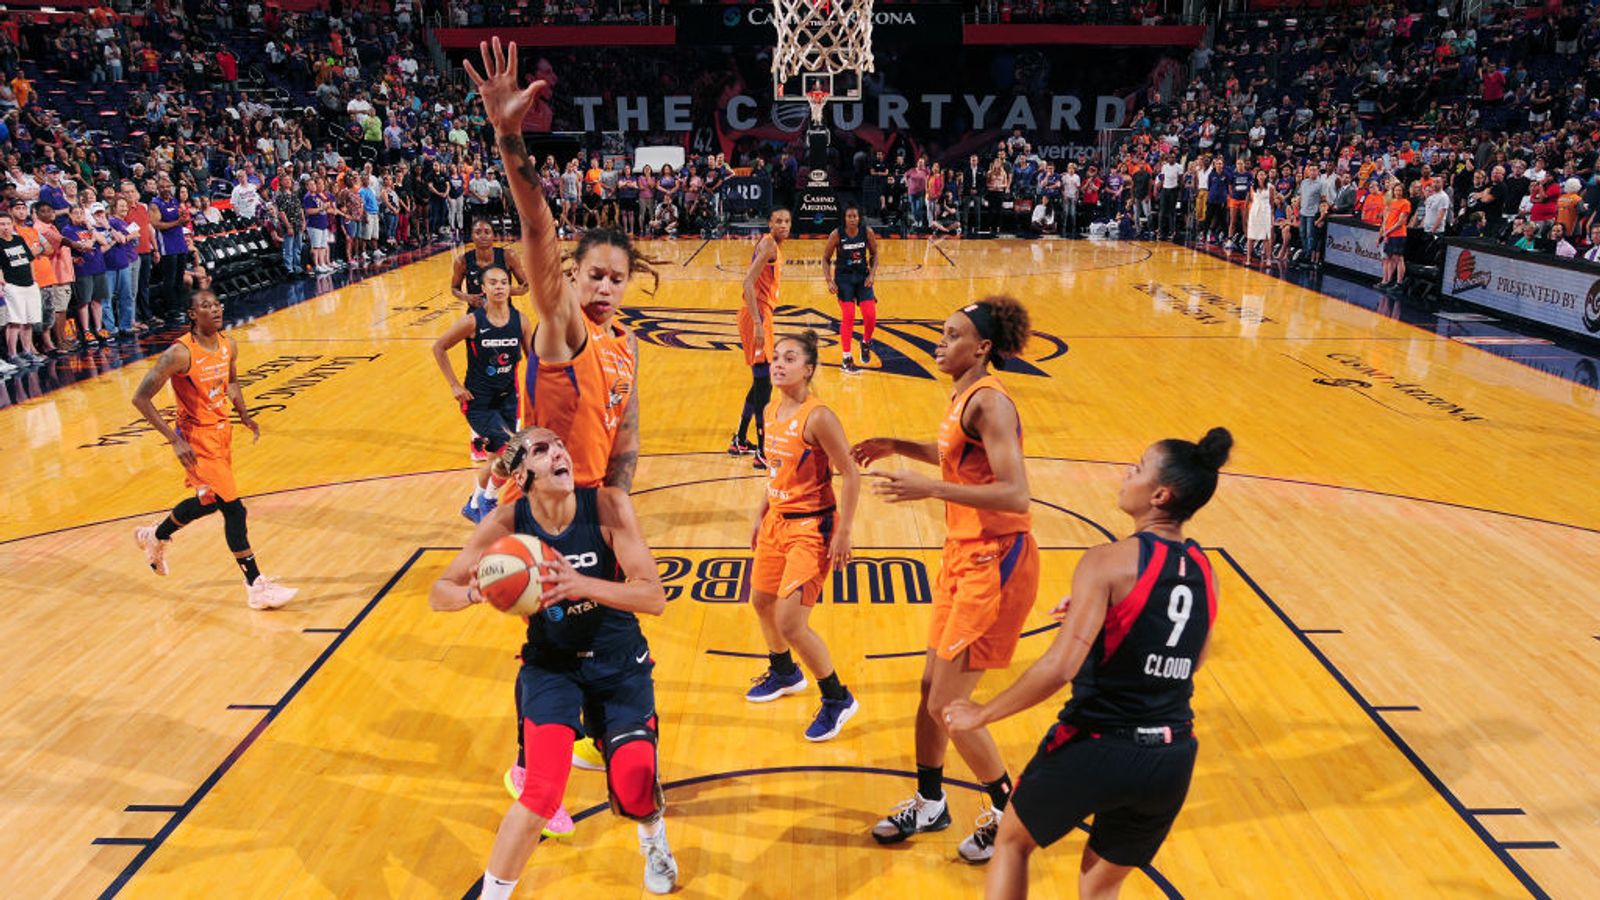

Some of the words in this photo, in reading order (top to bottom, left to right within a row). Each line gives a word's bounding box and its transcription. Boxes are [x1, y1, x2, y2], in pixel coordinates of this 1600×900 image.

[574, 95, 693, 131] THE
[800, 203, 838, 212] ARIZONA
[803, 193, 835, 203] CASINO
[1496, 276, 1561, 305] PRESENTED
[1561, 291, 1579, 310] BY
[481, 338, 518, 348] GEICO
[567, 600, 599, 616] AT&T
[1166, 585, 1194, 647] 9
[1144, 654, 1192, 680] CLOUD
